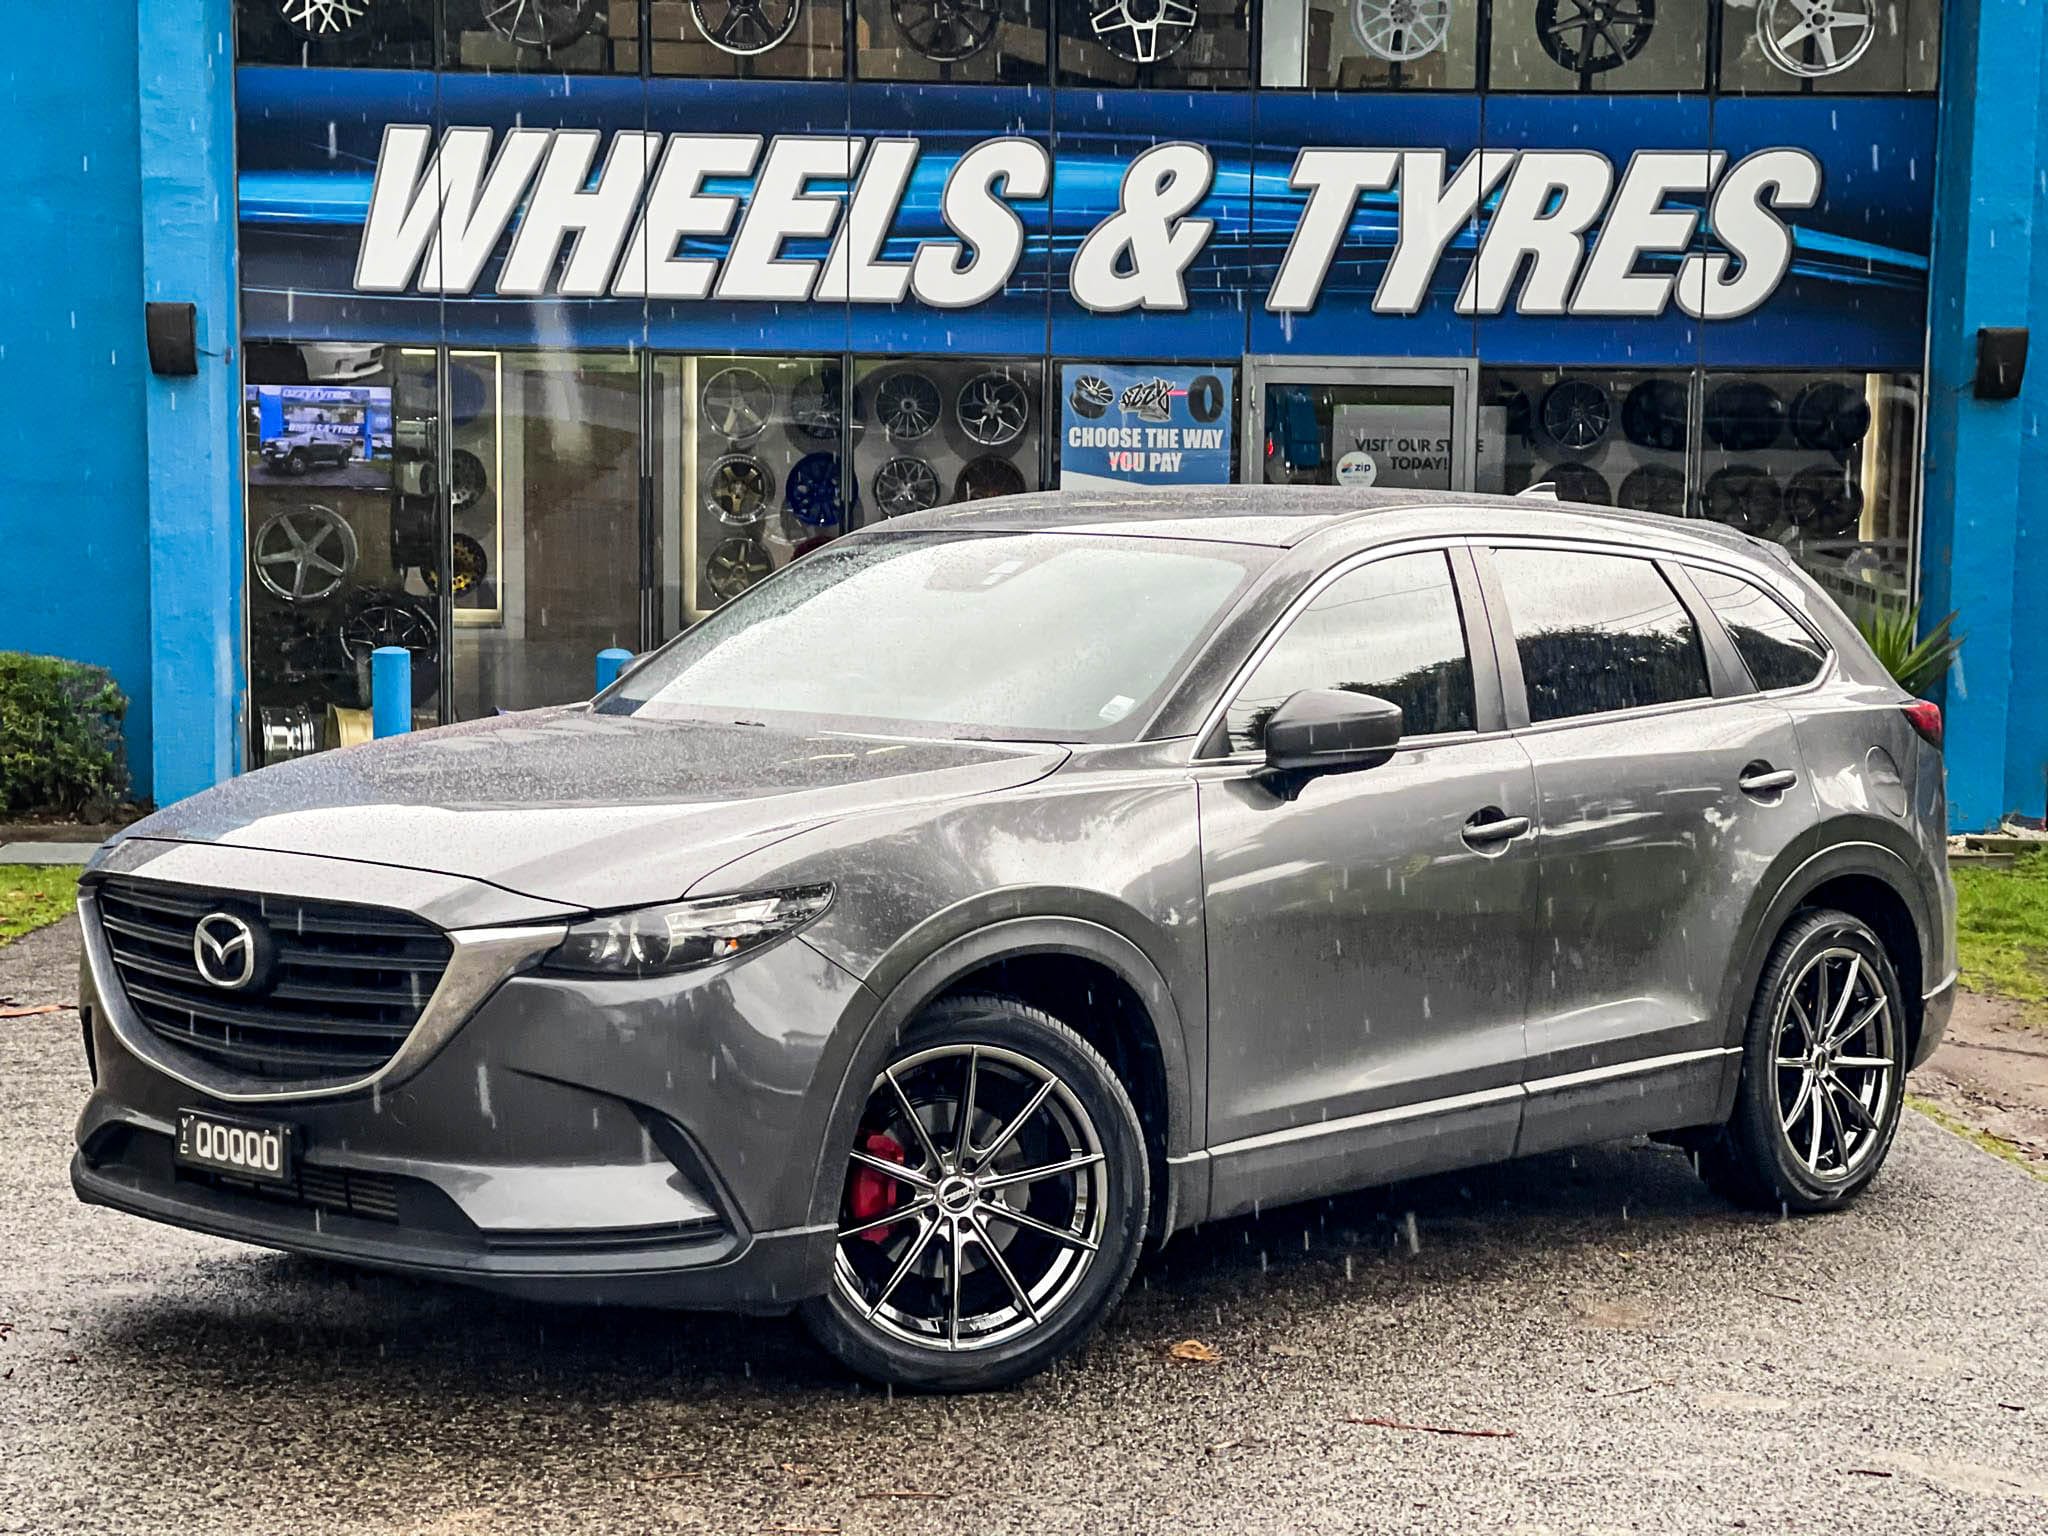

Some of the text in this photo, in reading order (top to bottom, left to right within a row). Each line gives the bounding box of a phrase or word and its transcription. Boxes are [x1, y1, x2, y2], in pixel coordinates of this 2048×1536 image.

[353, 124, 1822, 320] WHEELS & TYRES
[1068, 427, 1224, 449] CHOOSE THE WAY
[1355, 438, 1484, 453] VISIT OUR STE
[1109, 451, 1183, 473] YOU PAY
[1354, 461, 1371, 472] zip
[1390, 456, 1448, 470] TODAY!
